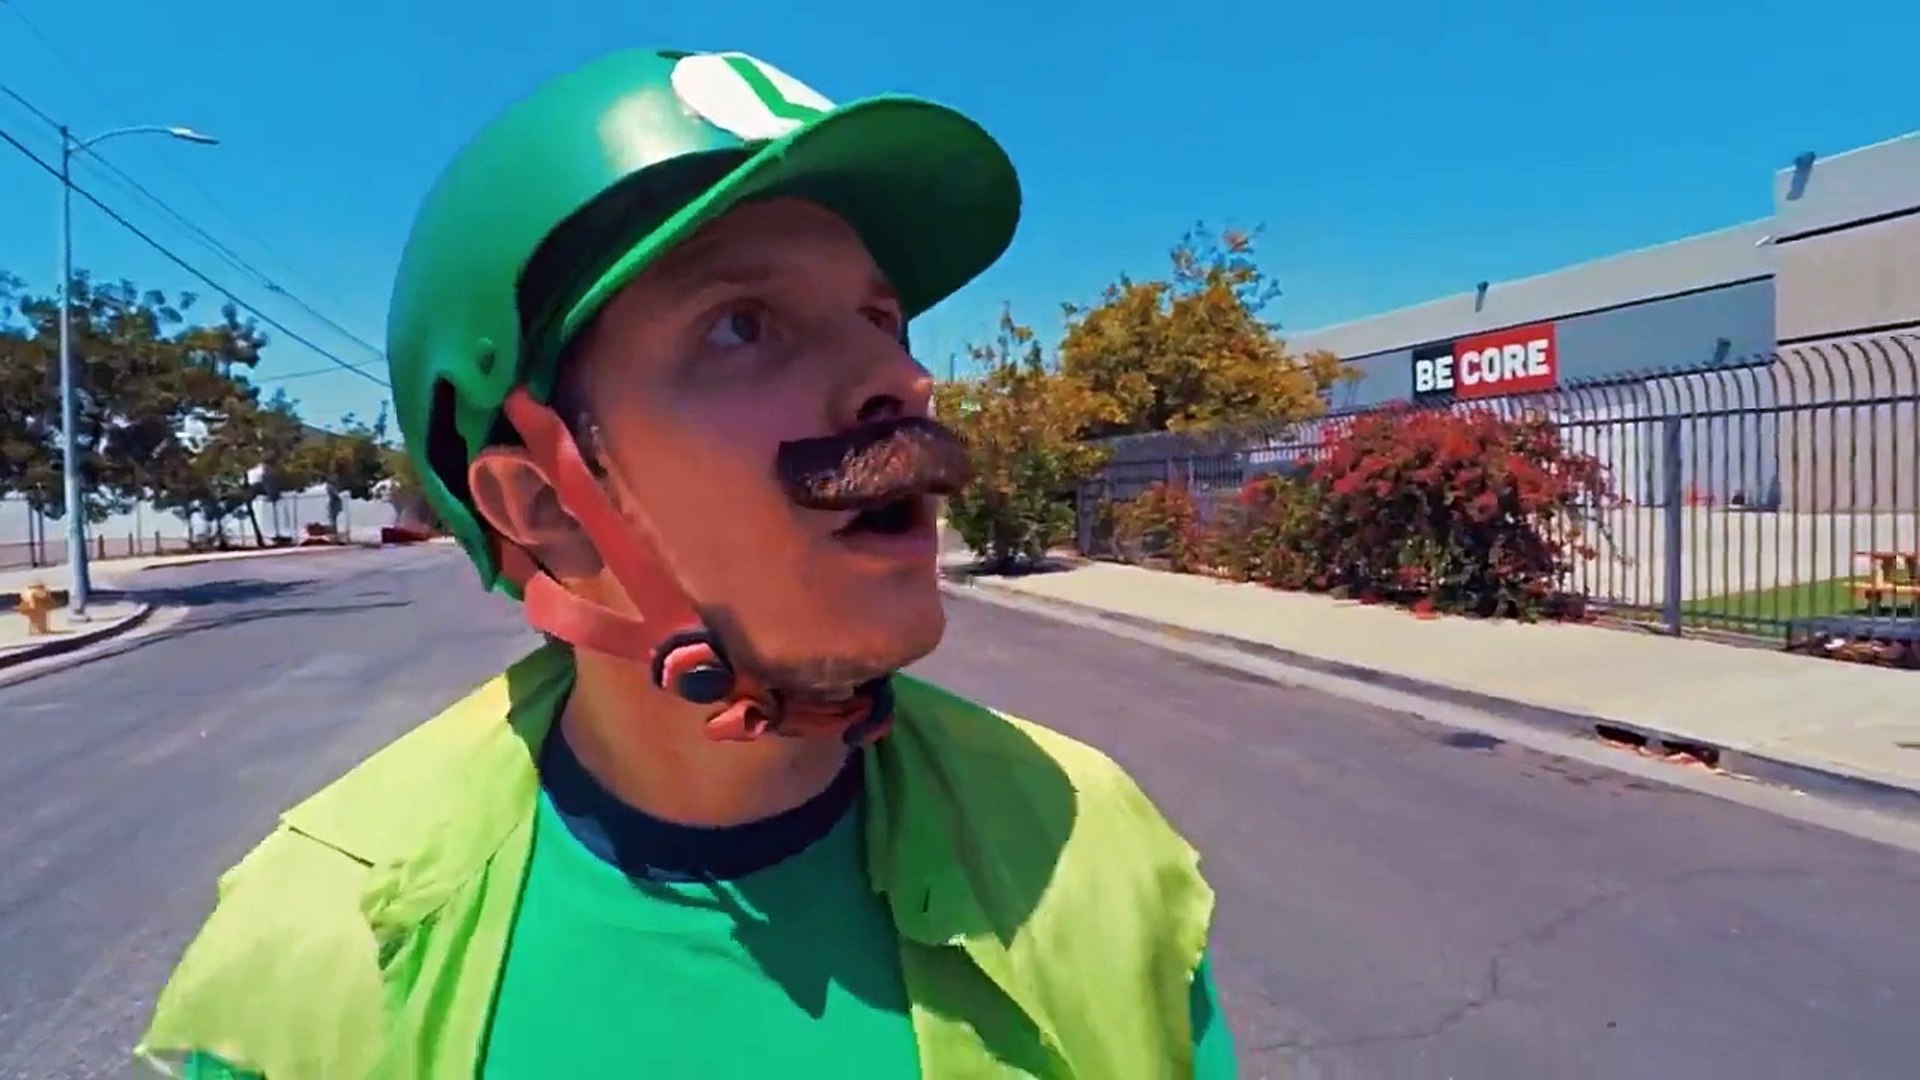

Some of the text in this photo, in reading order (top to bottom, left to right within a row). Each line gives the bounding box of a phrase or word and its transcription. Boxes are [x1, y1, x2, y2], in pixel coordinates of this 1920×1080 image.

[721, 56, 825, 125] L
[1415, 339, 1550, 392] BE CORE
